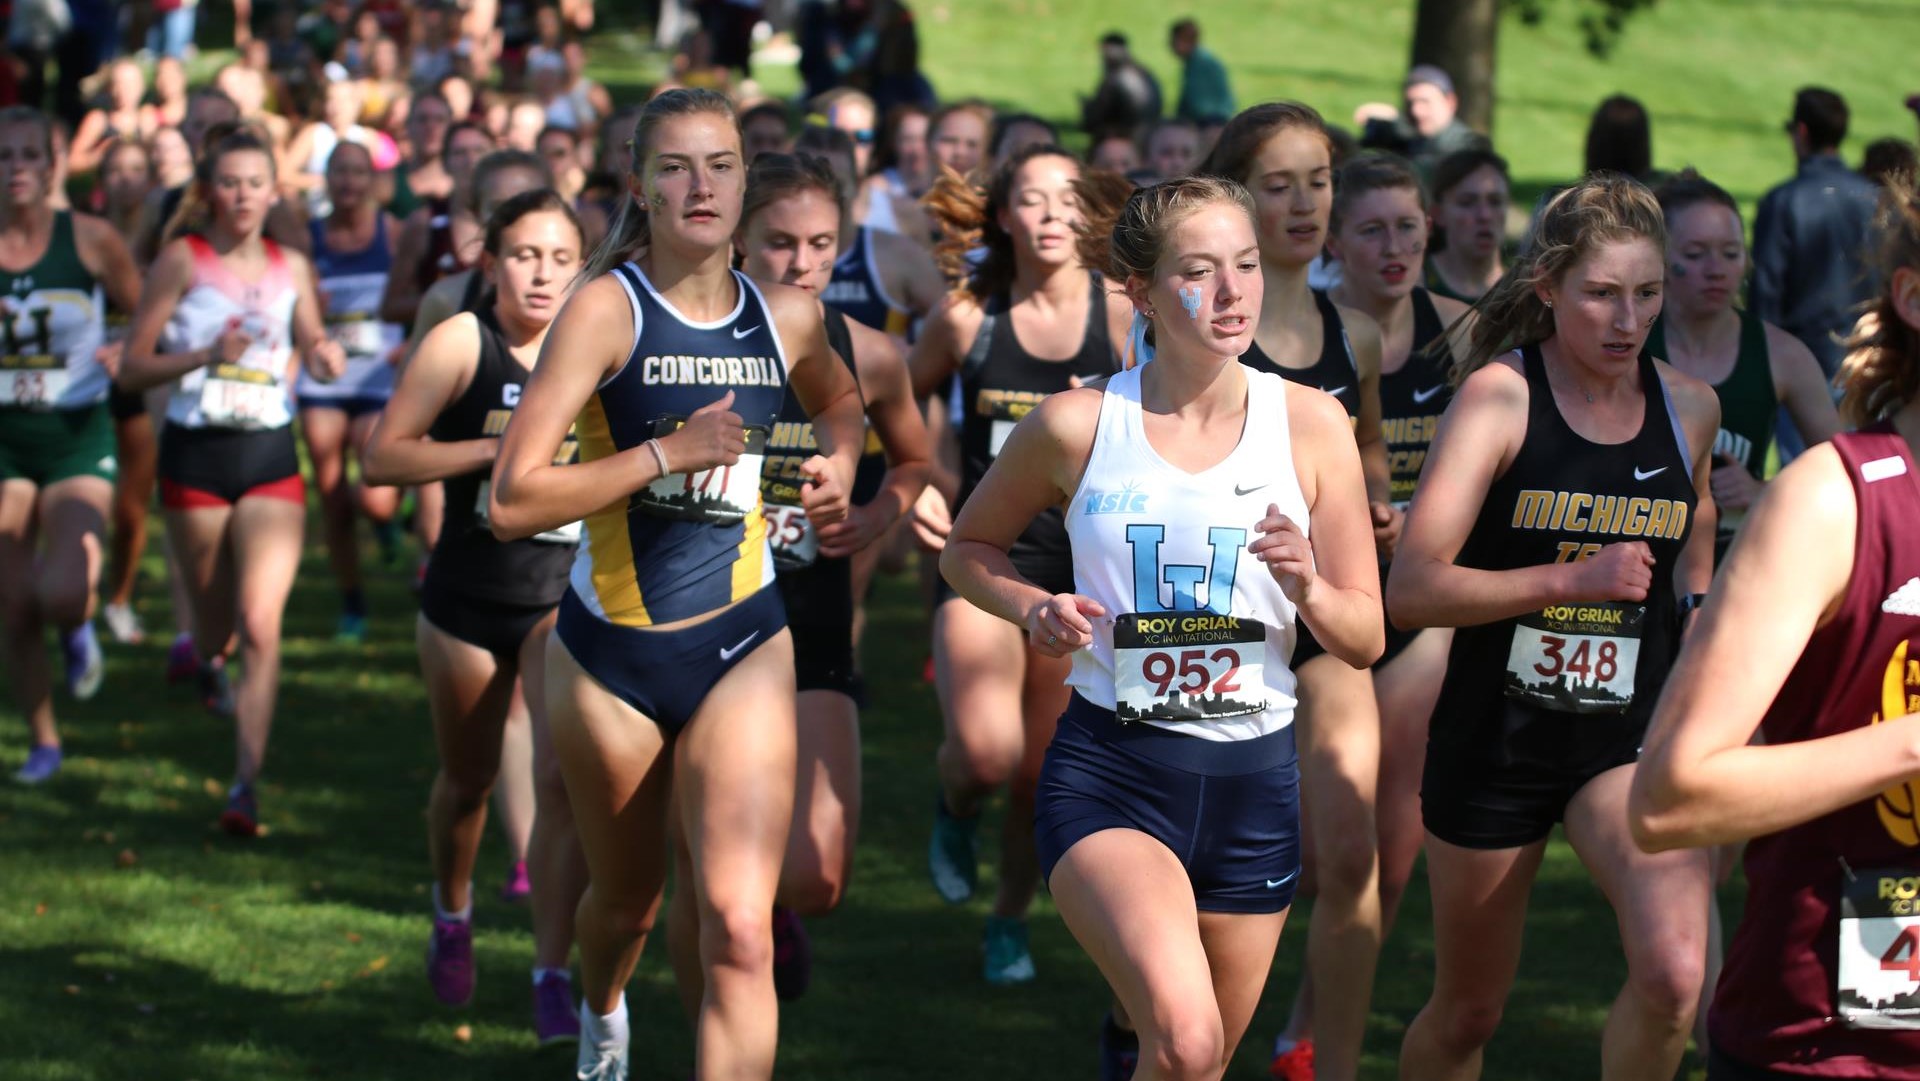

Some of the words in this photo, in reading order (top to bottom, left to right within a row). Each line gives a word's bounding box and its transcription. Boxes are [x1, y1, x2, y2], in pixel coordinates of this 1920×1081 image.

[643, 355, 781, 387] CONCORDIA
[1086, 487, 1149, 514] NSIC
[1511, 489, 1688, 541] MICHIGAN
[1137, 617, 1176, 634] ROY
[1181, 616, 1241, 632] GRIAK
[1543, 605, 1576, 621] ROY
[1577, 607, 1623, 624] GRIAK
[1547, 621, 1562, 631] XC
[1563, 622, 1616, 634] INVITATIONAL
[1144, 634, 1160, 644] XC
[1163, 630, 1236, 644] INVITATIONAL
[1533, 635, 1618, 682] 348
[1142, 647, 1241, 697] 952
[1878, 876, 1920, 901] RO
